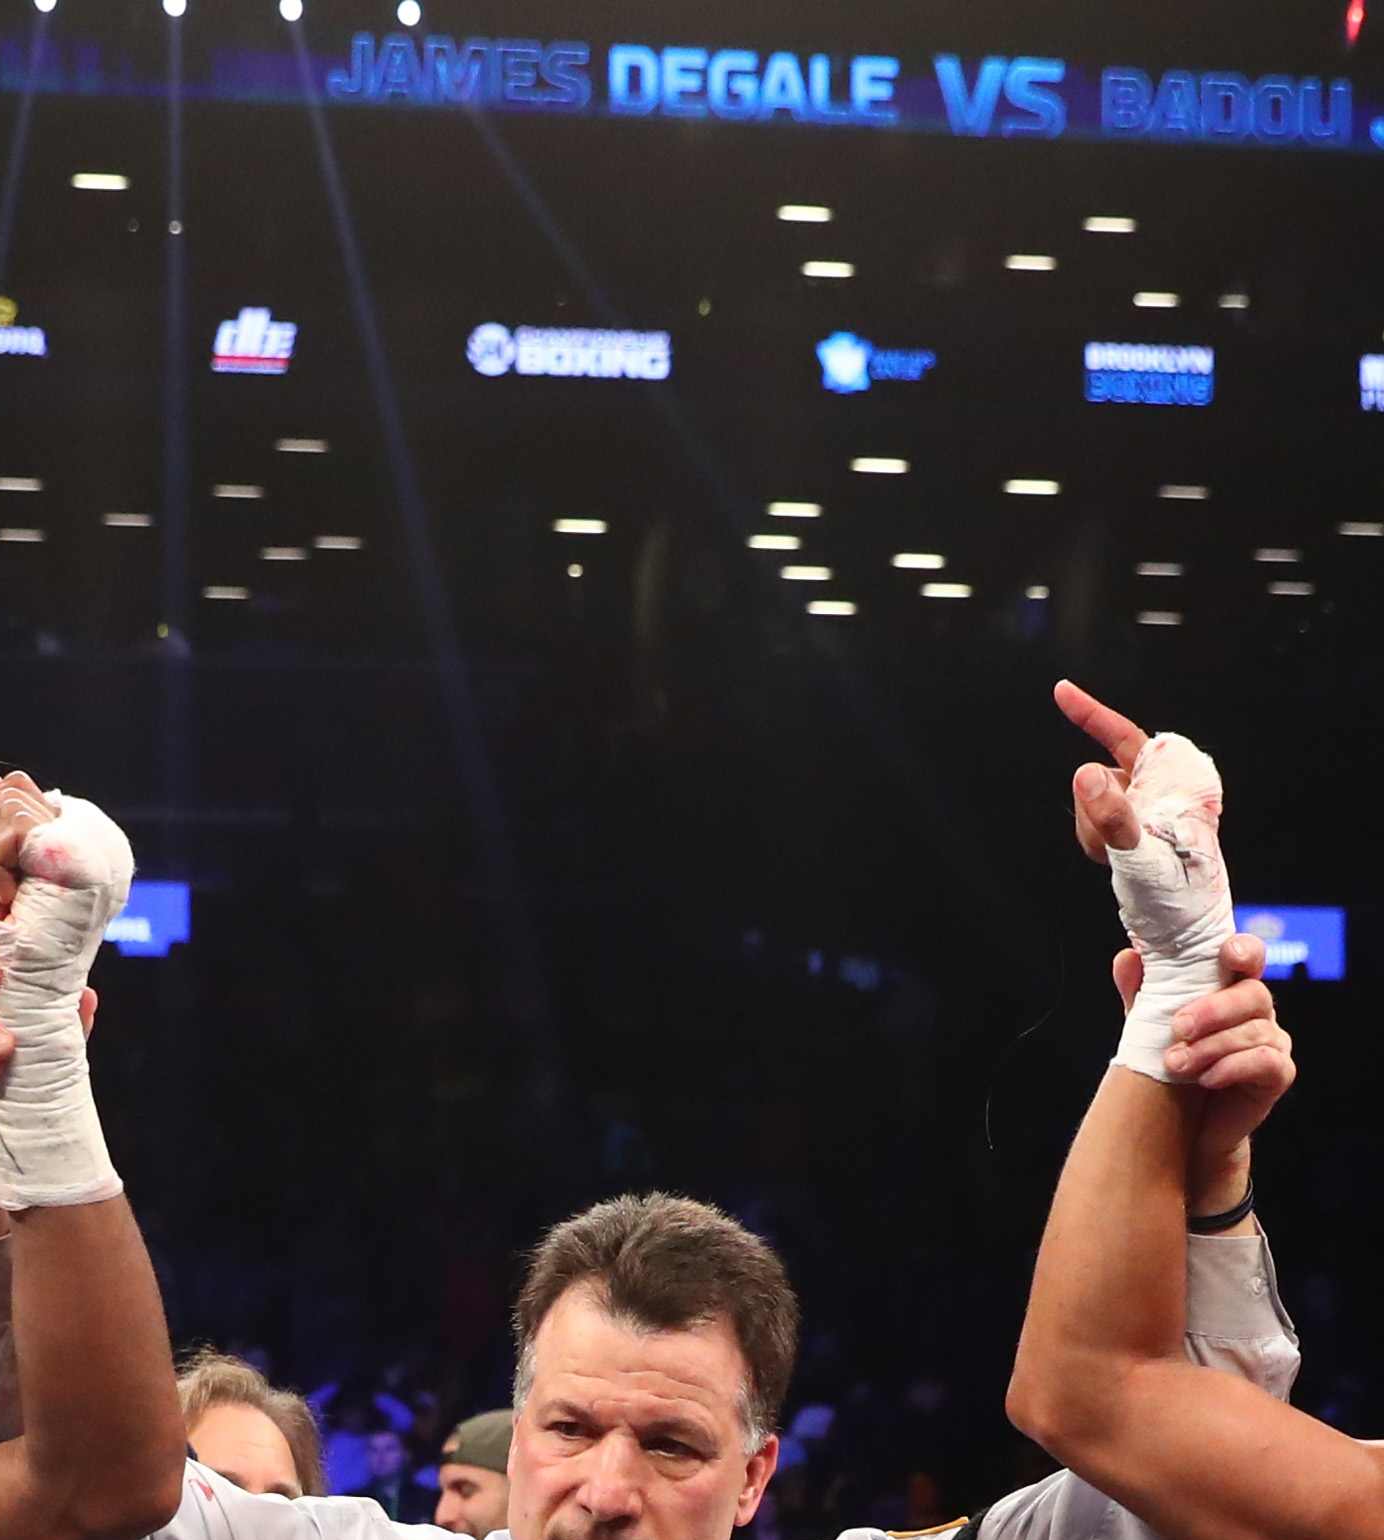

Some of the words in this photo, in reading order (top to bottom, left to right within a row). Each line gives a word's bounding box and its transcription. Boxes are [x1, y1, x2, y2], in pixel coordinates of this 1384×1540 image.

[326, 32, 591, 112] JAMES
[609, 44, 900, 124] DEGALE
[933, 53, 1066, 139] VS
[1101, 67, 1351, 145] BADOU
